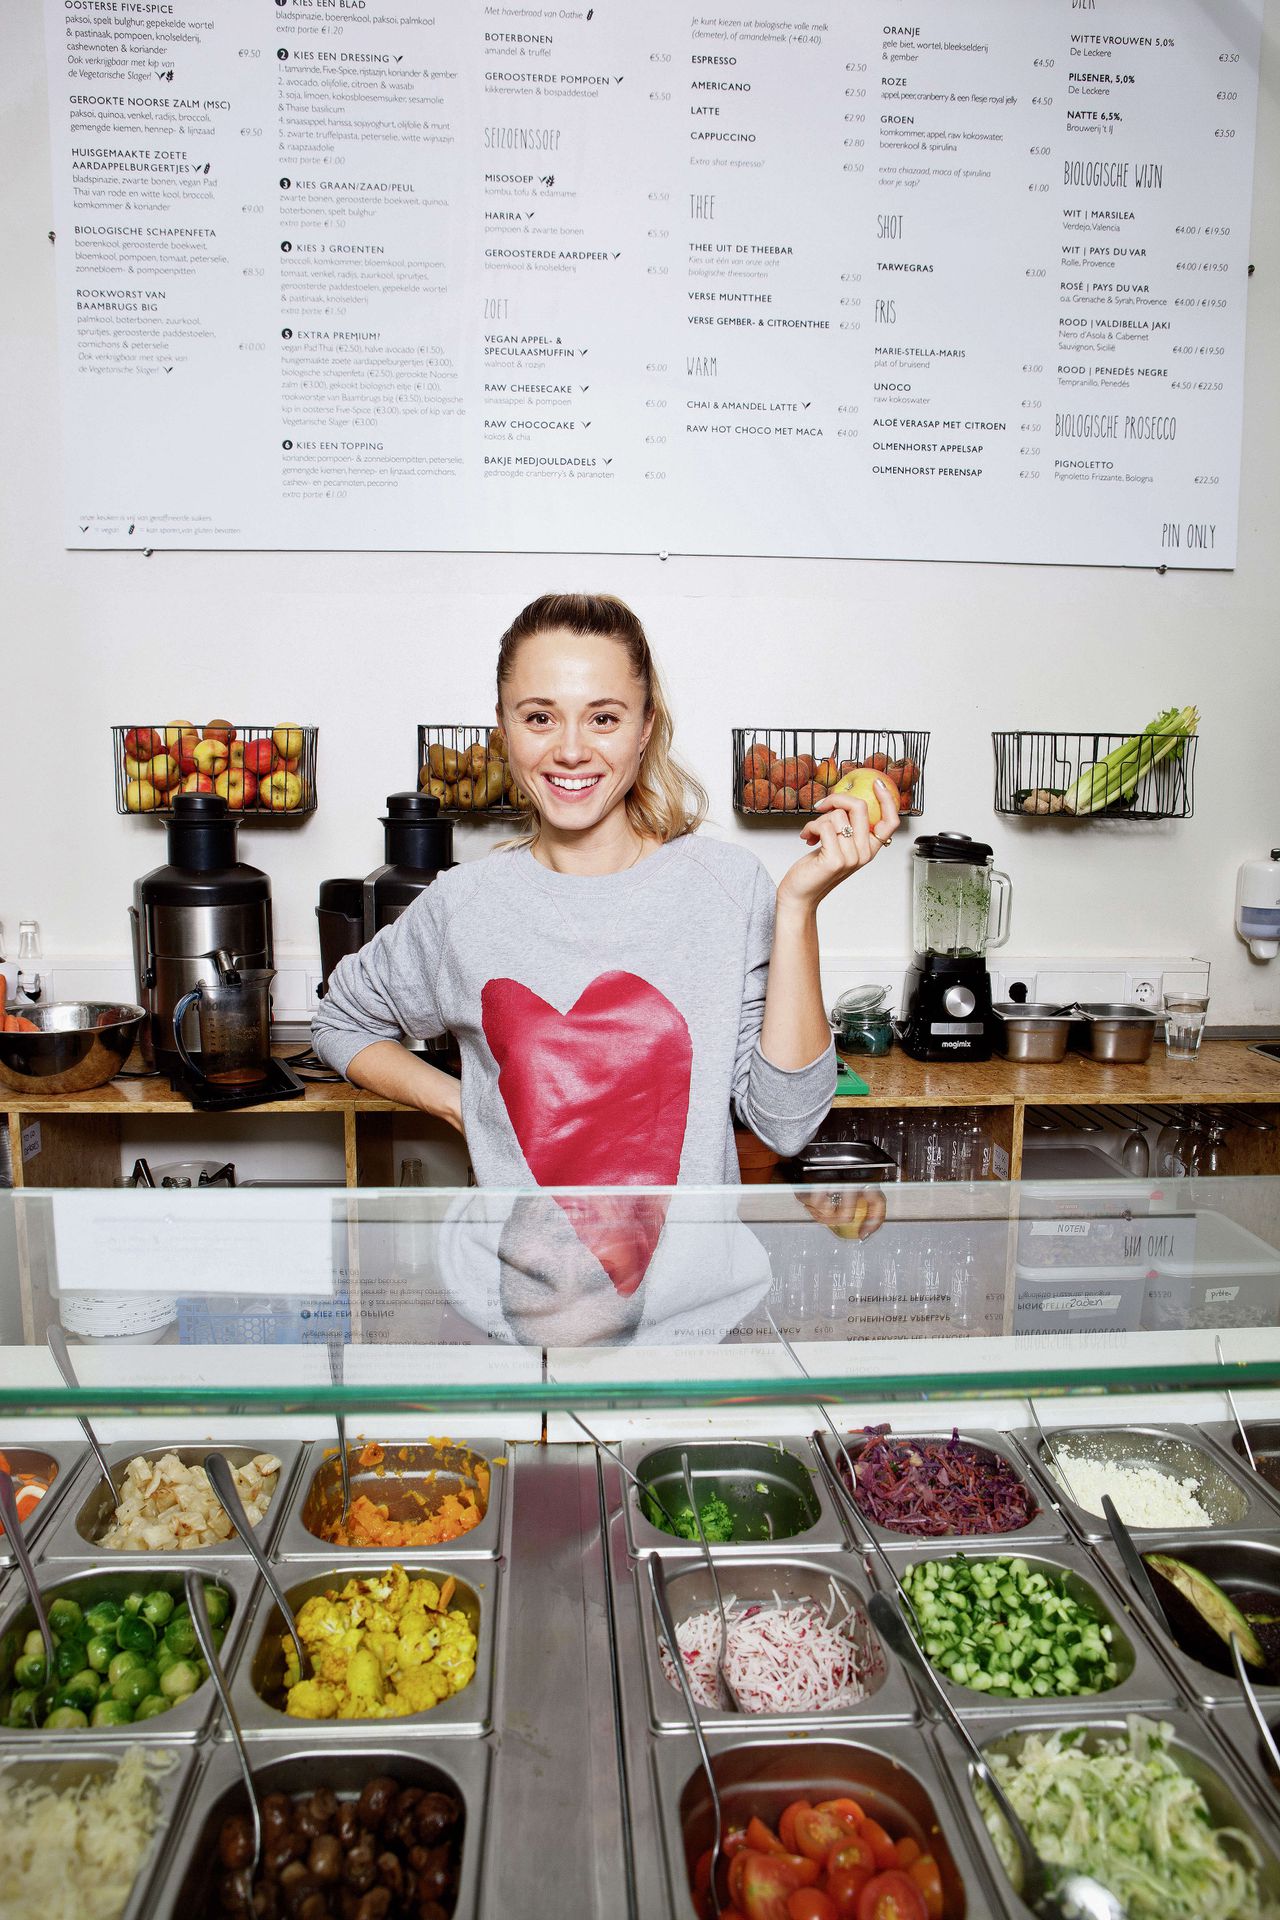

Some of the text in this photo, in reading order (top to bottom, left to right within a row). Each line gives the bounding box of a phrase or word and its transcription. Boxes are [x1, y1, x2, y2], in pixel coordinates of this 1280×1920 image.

[65, 1, 173, 14] OOSTERSE FIVE-SPICE
[340, 1, 366, 9] BLAD
[883, 26, 920, 38] ORANJE
[485, 33, 552, 44] BOTERBONEN
[1071, 35, 1101, 44] WITTE
[1103, 36, 1152, 46] VROUWEN
[294, 51, 389, 63] KIES EEN DRESSING
[1070, 47, 1112, 58] De Leckere
[692, 55, 737, 65] ESPRESSO
[485, 72, 609, 85] GEROOSTERDE POMPOEN
[882, 78, 907, 86] ROZE
[1069, 73, 1113, 84] PILSENER,
[691, 81, 751, 92] AMERICANO
[69, 96, 231, 111] GEROOKTE NOORSE ZALM (MSC)
[691, 106, 720, 116] LATTE
[1067, 111, 1098, 120] NATTE
[881, 116, 914, 124] GROEN
[485, 128, 560, 150] SEIZOENSSOEP
[691, 132, 756, 142] CAPPUCCINO
[72, 148, 187, 160] HUISGEMAAKTE ZOETE
[72, 162, 192, 174] AARDAPPELBURGERTJES
[485, 174, 534, 183] MISOSOEP
[1064, 161, 1162, 189] BIOLOGISCHE WIJN
[296, 181, 414, 192] KIES GRAAN/ZAAD/PEUL
[690, 194, 715, 219] THEE
[485, 212, 522, 220] HARIRA
[1091, 211, 1135, 220] MARSILEA
[74, 226, 216, 237] BIOLOGISCHE SCHAPENFETA
[877, 215, 903, 239] SHOT
[297, 244, 317, 252] KIES
[329, 245, 384, 254] GROENTEN
[485, 249, 608, 260] GEROOSTERDE AARDPEER
[689, 243, 712, 252] THEE
[736, 245, 748, 253] DE
[751, 246, 793, 255] THEEBAR
[1090, 247, 1110, 256] PAYS
[1113, 248, 1128, 256] DU
[877, 263, 934, 272] TARWEGRAS
[1061, 281, 1083, 291] ROSÉ
[1093, 283, 1113, 292] PAYS
[1116, 284, 1130, 292] DU
[77, 289, 143, 298] ROOKWORST
[688, 292, 772, 303] VERSE MUNTTHEE
[77, 302, 138, 311] BAAMBRUGS
[484, 298, 508, 319] ZOET
[875, 300, 896, 323] FRIS
[688, 317, 714, 325] VERSE
[717, 318, 755, 326] GEMBER-
[767, 319, 829, 329] CITROENTHEE
[1060, 318, 1171, 331] ROOD VALDIBELLA JAKI
[298, 331, 380, 341] EXTRA PREMIUM?
[485, 335, 518, 343] VEGAN
[521, 336, 552, 344] APPEL-
[485, 347, 574, 357] SPECULAASMUFFIN
[875, 347, 966, 358] MARIE-STELLA-MARIS
[687, 357, 717, 376] WARM
[1058, 366, 1086, 374] ROOD
[1138, 369, 1168, 377] NEGRE
[511, 385, 572, 393] CHEESECAKE
[874, 383, 911, 391] UNOCO
[722, 402, 767, 411] AMANDEL
[770, 404, 798, 412] LATTE
[485, 420, 575, 430] RAW CHOCOCAKE
[900, 420, 940, 428] VERASAP
[943, 421, 961, 429] MET
[965, 422, 1006, 430] CITROEN
[1055, 413, 1176, 441] BIOLOGISCHE PROSECCO
[735, 426, 772, 434] CHOCO
[796, 428, 823, 436] MACA
[341, 442, 384, 450] TOPPING
[873, 442, 983, 453] OLMENHORST APPELSAP
[484, 456, 596, 467] BAKJE MEDJOULDADELS
[1055, 460, 1114, 469] PIGNOLETTO
[872, 466, 982, 477] OLMENHORST PERENSAP
[1162, 523, 1216, 549] PIN ONLY
[942, 1040, 971, 1049] magimix
[1057, 1224, 1085, 1233] NOTEN
